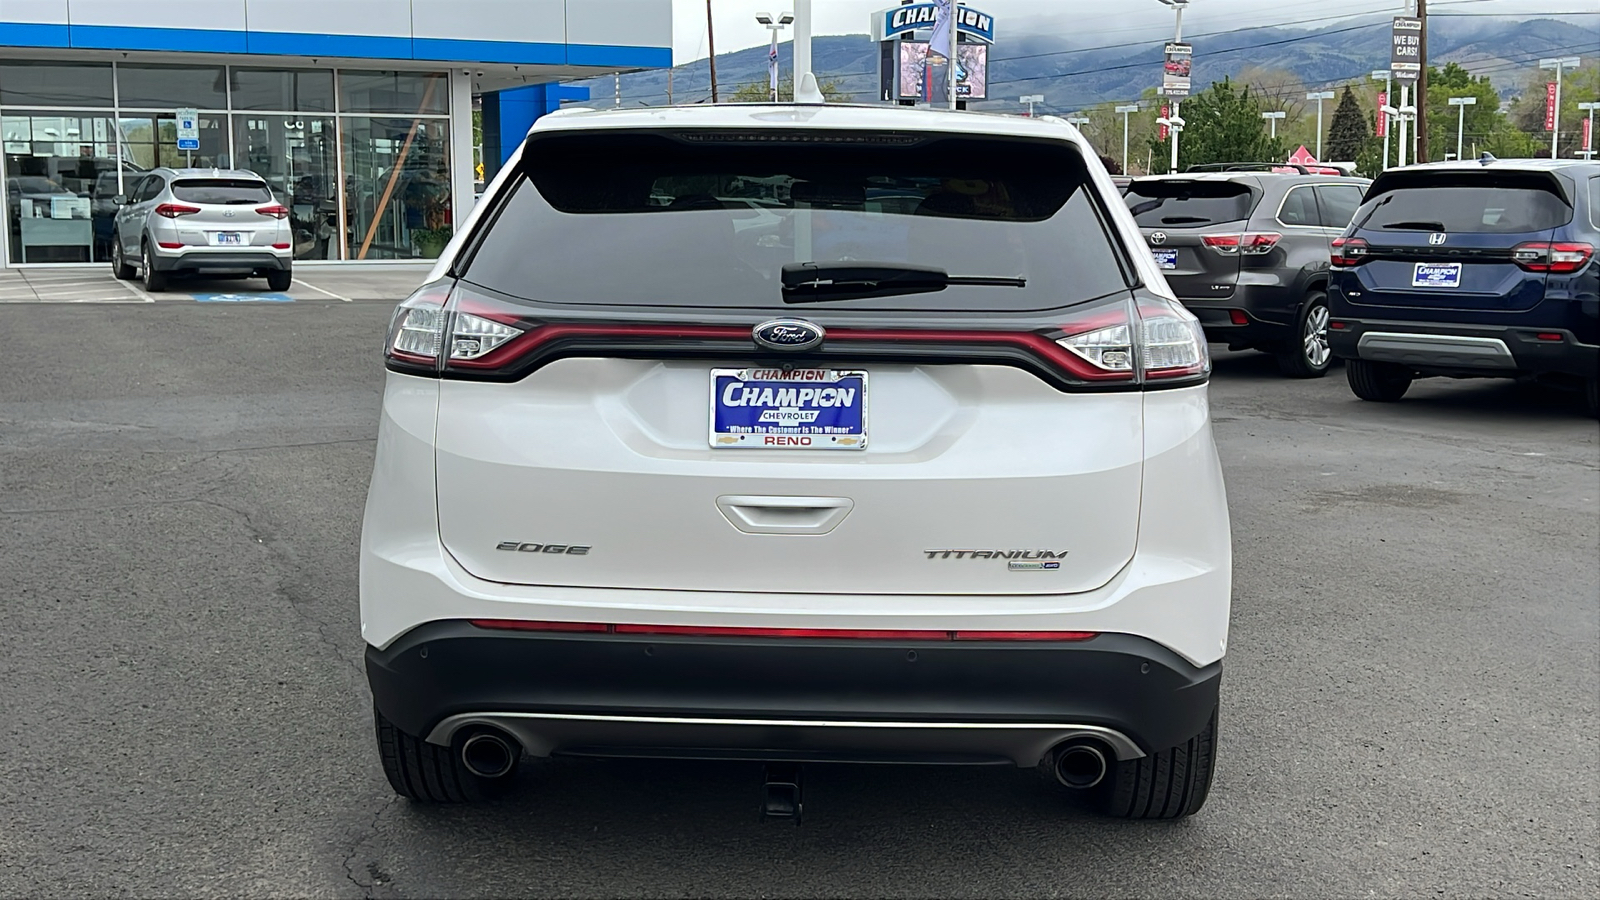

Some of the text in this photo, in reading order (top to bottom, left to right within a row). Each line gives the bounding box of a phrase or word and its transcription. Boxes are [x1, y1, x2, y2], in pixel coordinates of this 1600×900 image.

[892, 6, 991, 31] CHAION
[1394, 35, 1420, 46] WE BUY
[1396, 46, 1418, 56] CARS!
[1547, 95, 1555, 128] NISSAN
[1418, 266, 1458, 275] CHAMPION
[769, 326, 807, 342] Ford
[752, 369, 826, 381] CHAMPION
[722, 382, 856, 408] CHAMPION
[763, 412, 815, 420] CHEVROLET
[753, 425, 767, 434] The
[768, 425, 802, 434] Customer
[810, 426, 824, 434] The
[764, 436, 812, 446] RENO
[496, 540, 593, 555] EDGE
[924, 549, 1070, 560] TITANIUM
